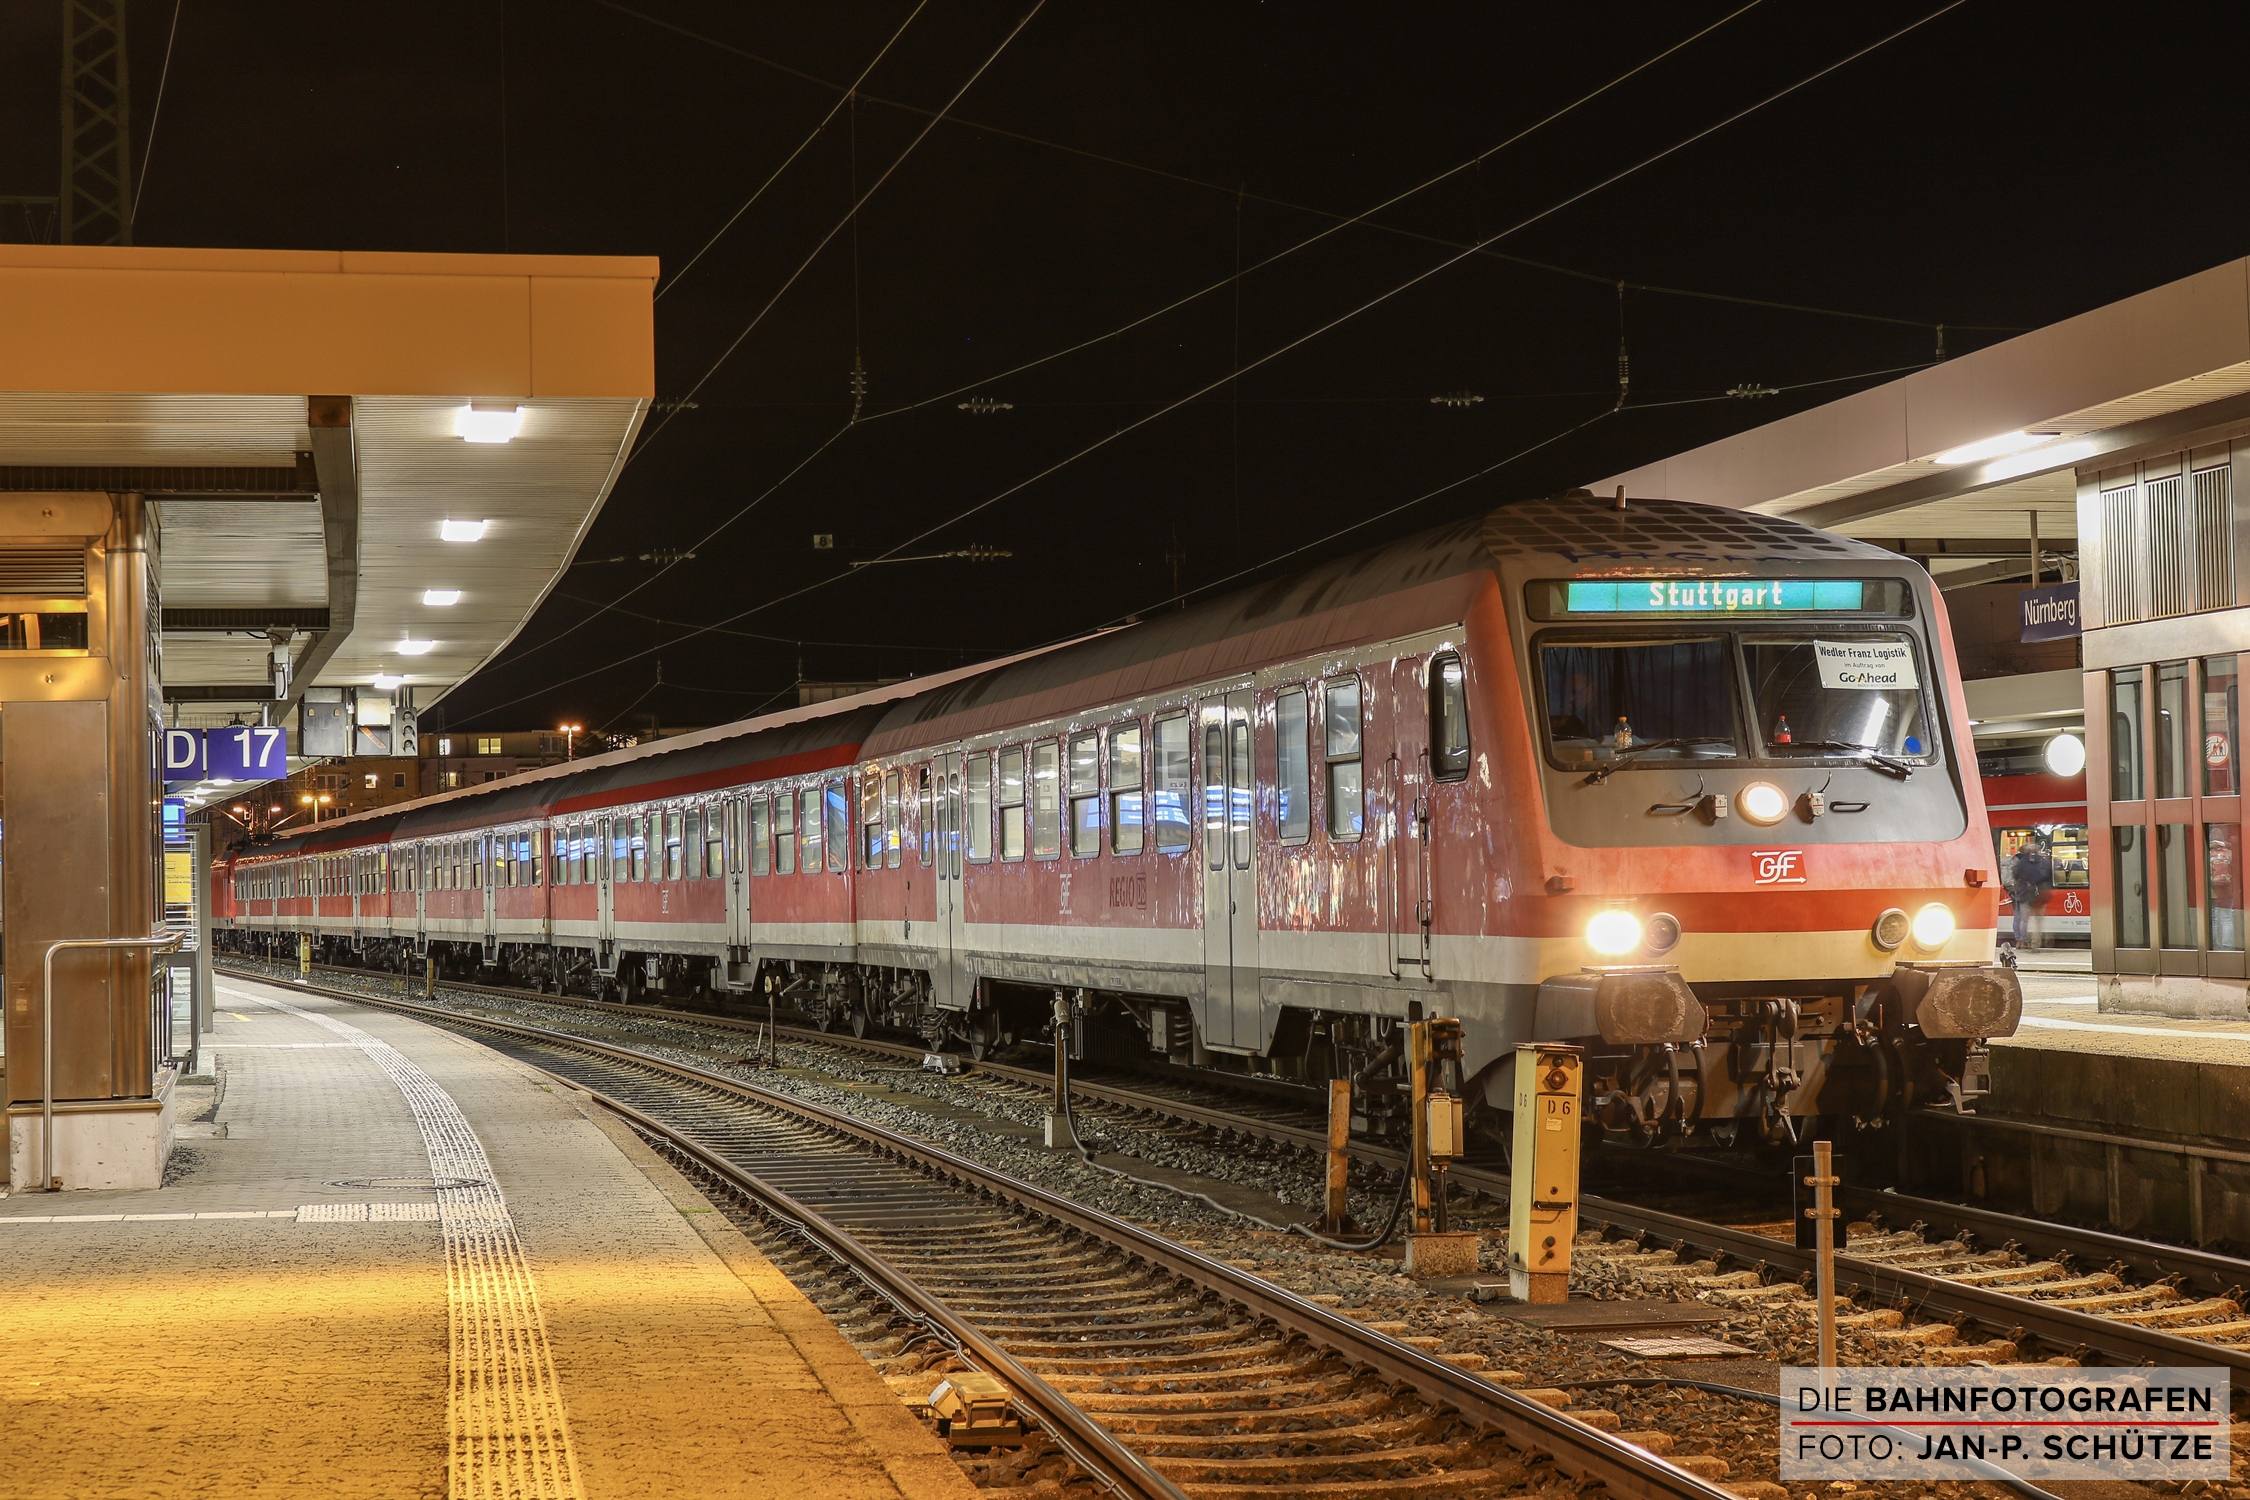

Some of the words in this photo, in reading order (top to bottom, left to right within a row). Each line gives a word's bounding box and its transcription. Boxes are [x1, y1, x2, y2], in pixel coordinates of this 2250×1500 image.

[820, 536, 828, 547] 8
[1649, 580, 1783, 610] Stuttgart
[2024, 596, 2076, 626] Nürnberg
[1819, 646, 1846, 658] Wedler
[1848, 648, 1871, 658] Franz
[1873, 648, 1907, 660] Logistik
[166, 730, 197, 769] D
[233, 729, 280, 768] 17
[2040, 840, 2046, 854] 2
[1109, 876, 1135, 908] REGIO
